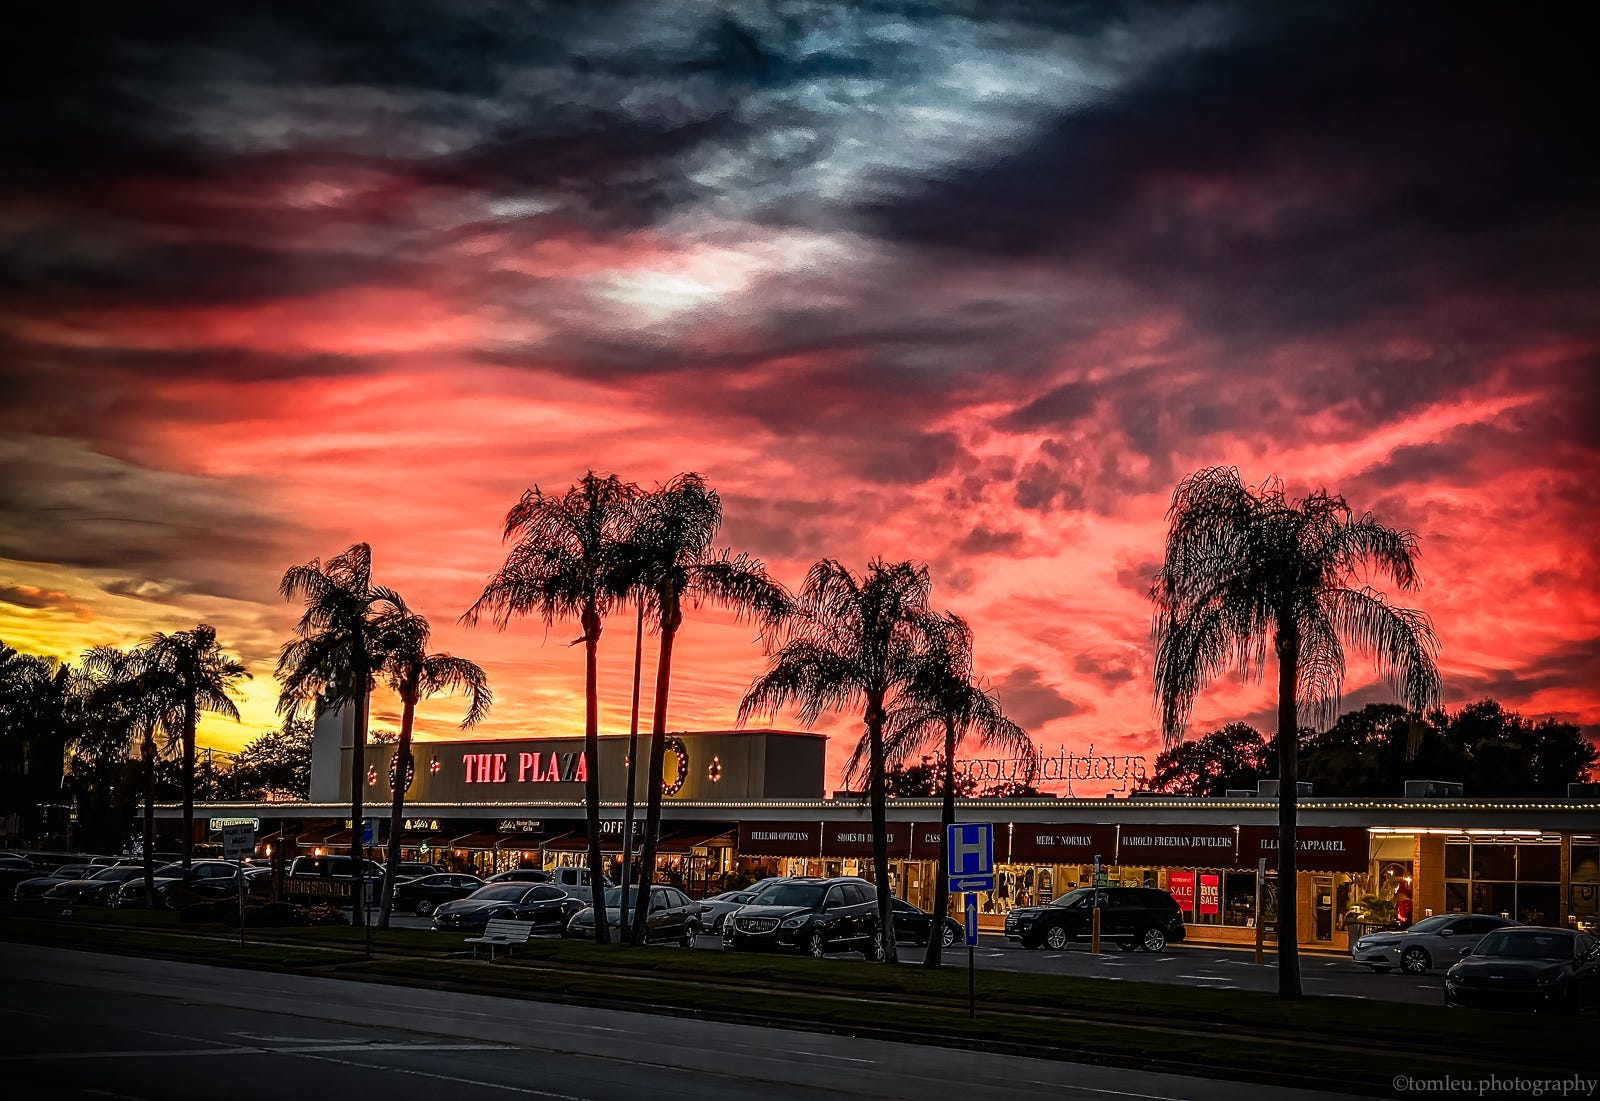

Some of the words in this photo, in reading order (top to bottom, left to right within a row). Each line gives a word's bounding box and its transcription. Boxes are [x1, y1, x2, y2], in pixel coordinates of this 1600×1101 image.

[463, 753, 507, 783] THE
[517, 751, 588, 783] PLAZA
[599, 821, 638, 834] COFFE
[778, 831, 809, 841] OPTICIANS
[837, 833, 857, 843] SHOES
[1036, 835, 1060, 846] MERL
[1060, 835, 1092, 846] NORMAN
[1122, 836, 1153, 846] HAROLD
[1154, 836, 1190, 847] FREEMAN
[1190, 836, 1232, 848] JEWELERS
[1300, 840, 1346, 851] APPAREL
[953, 826, 987, 873] H
[1170, 886, 1192, 896] SALE
[1200, 886, 1218, 896] BIG
[1200, 896, 1218, 905] SALE
